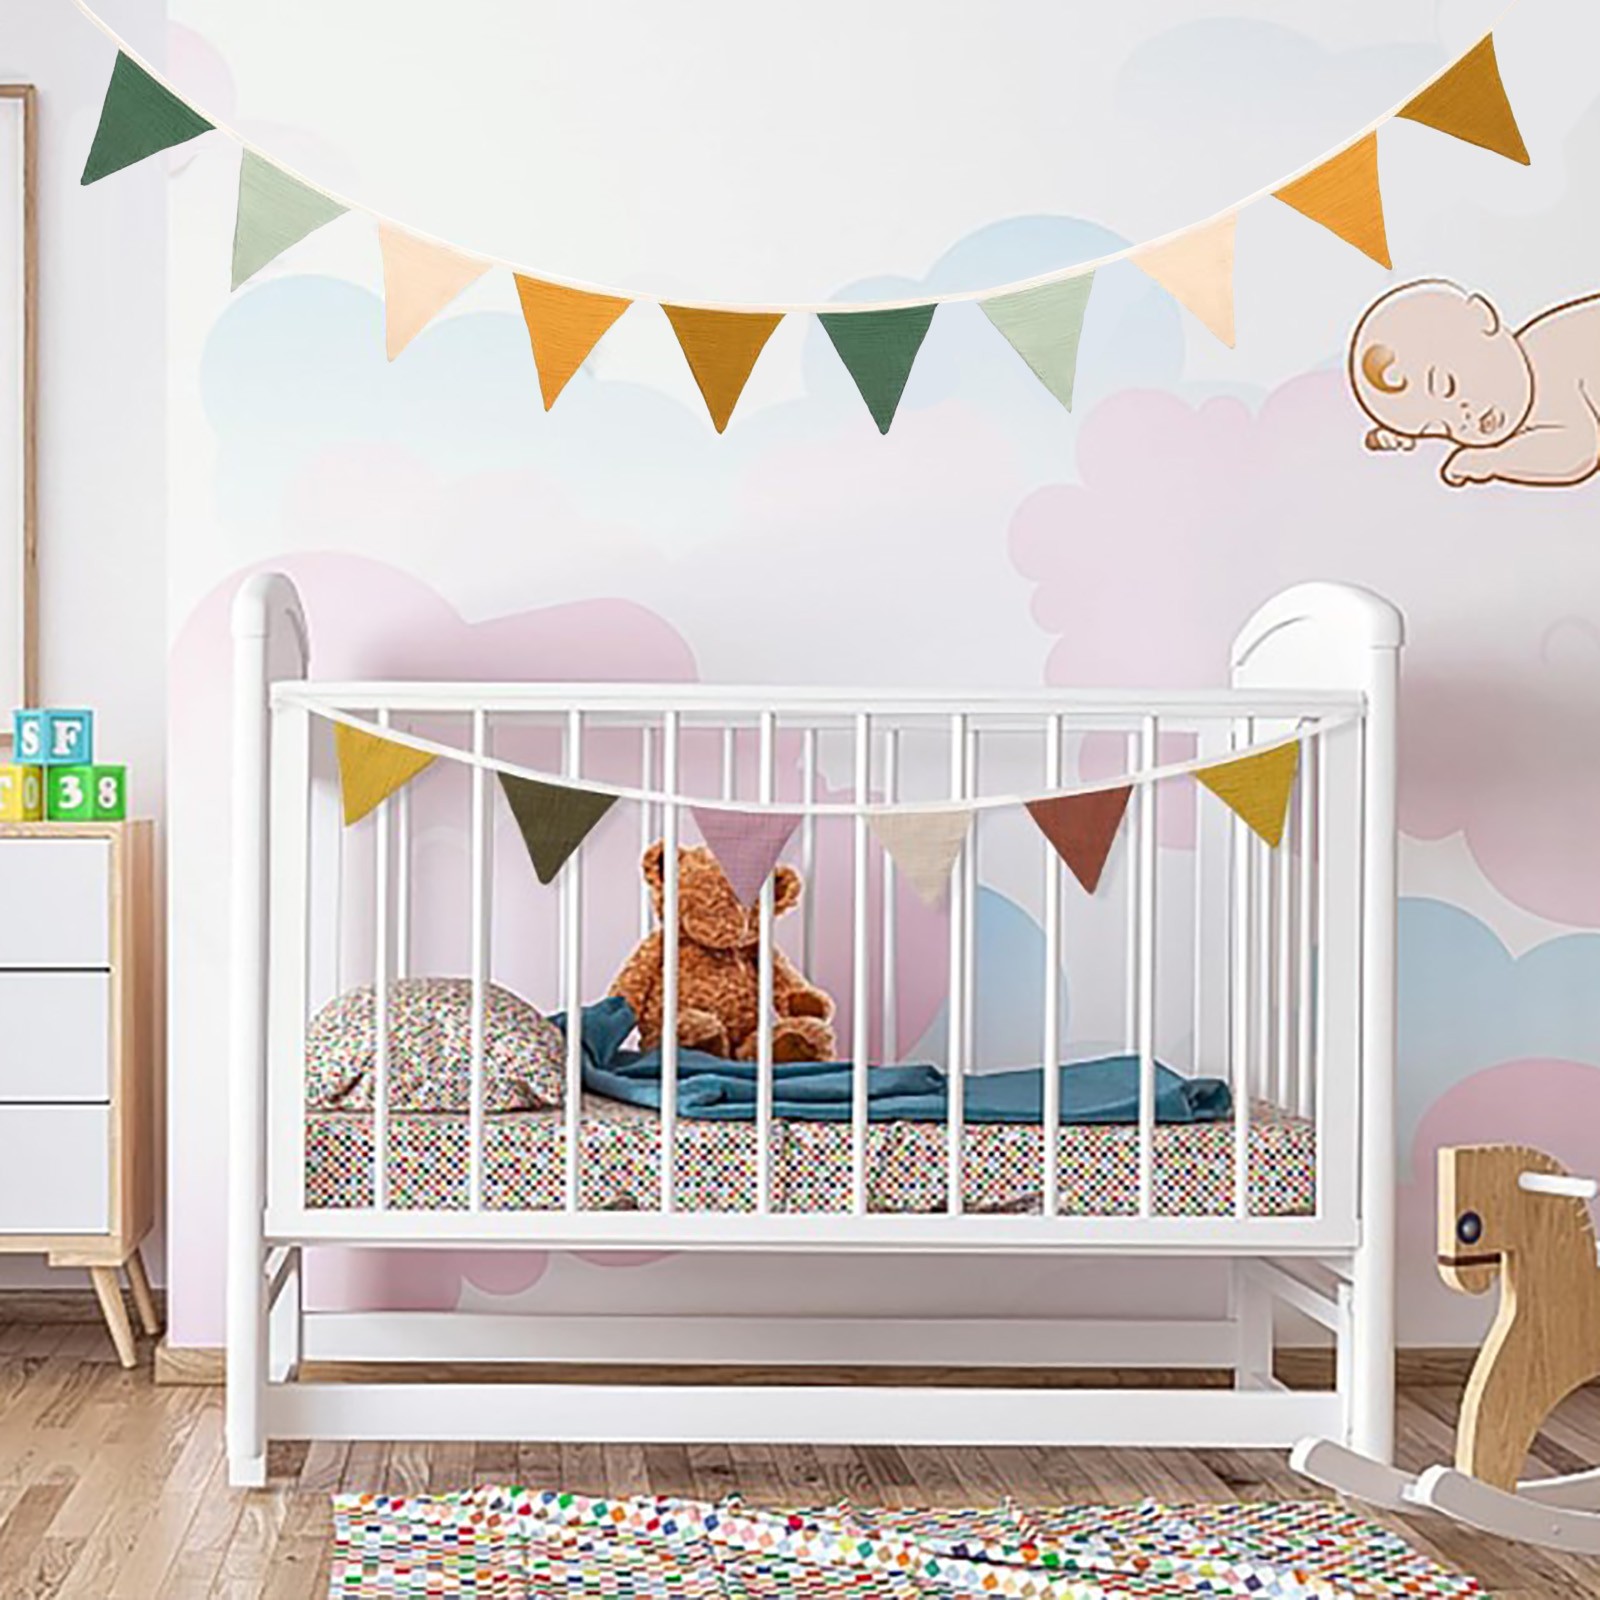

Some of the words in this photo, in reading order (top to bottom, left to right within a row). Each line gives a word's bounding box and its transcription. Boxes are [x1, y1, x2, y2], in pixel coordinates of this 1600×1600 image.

[21, 720, 40, 755] S
[52, 720, 82, 755] F
[58, 775, 83, 808] 3
[98, 776, 117, 808] 8
